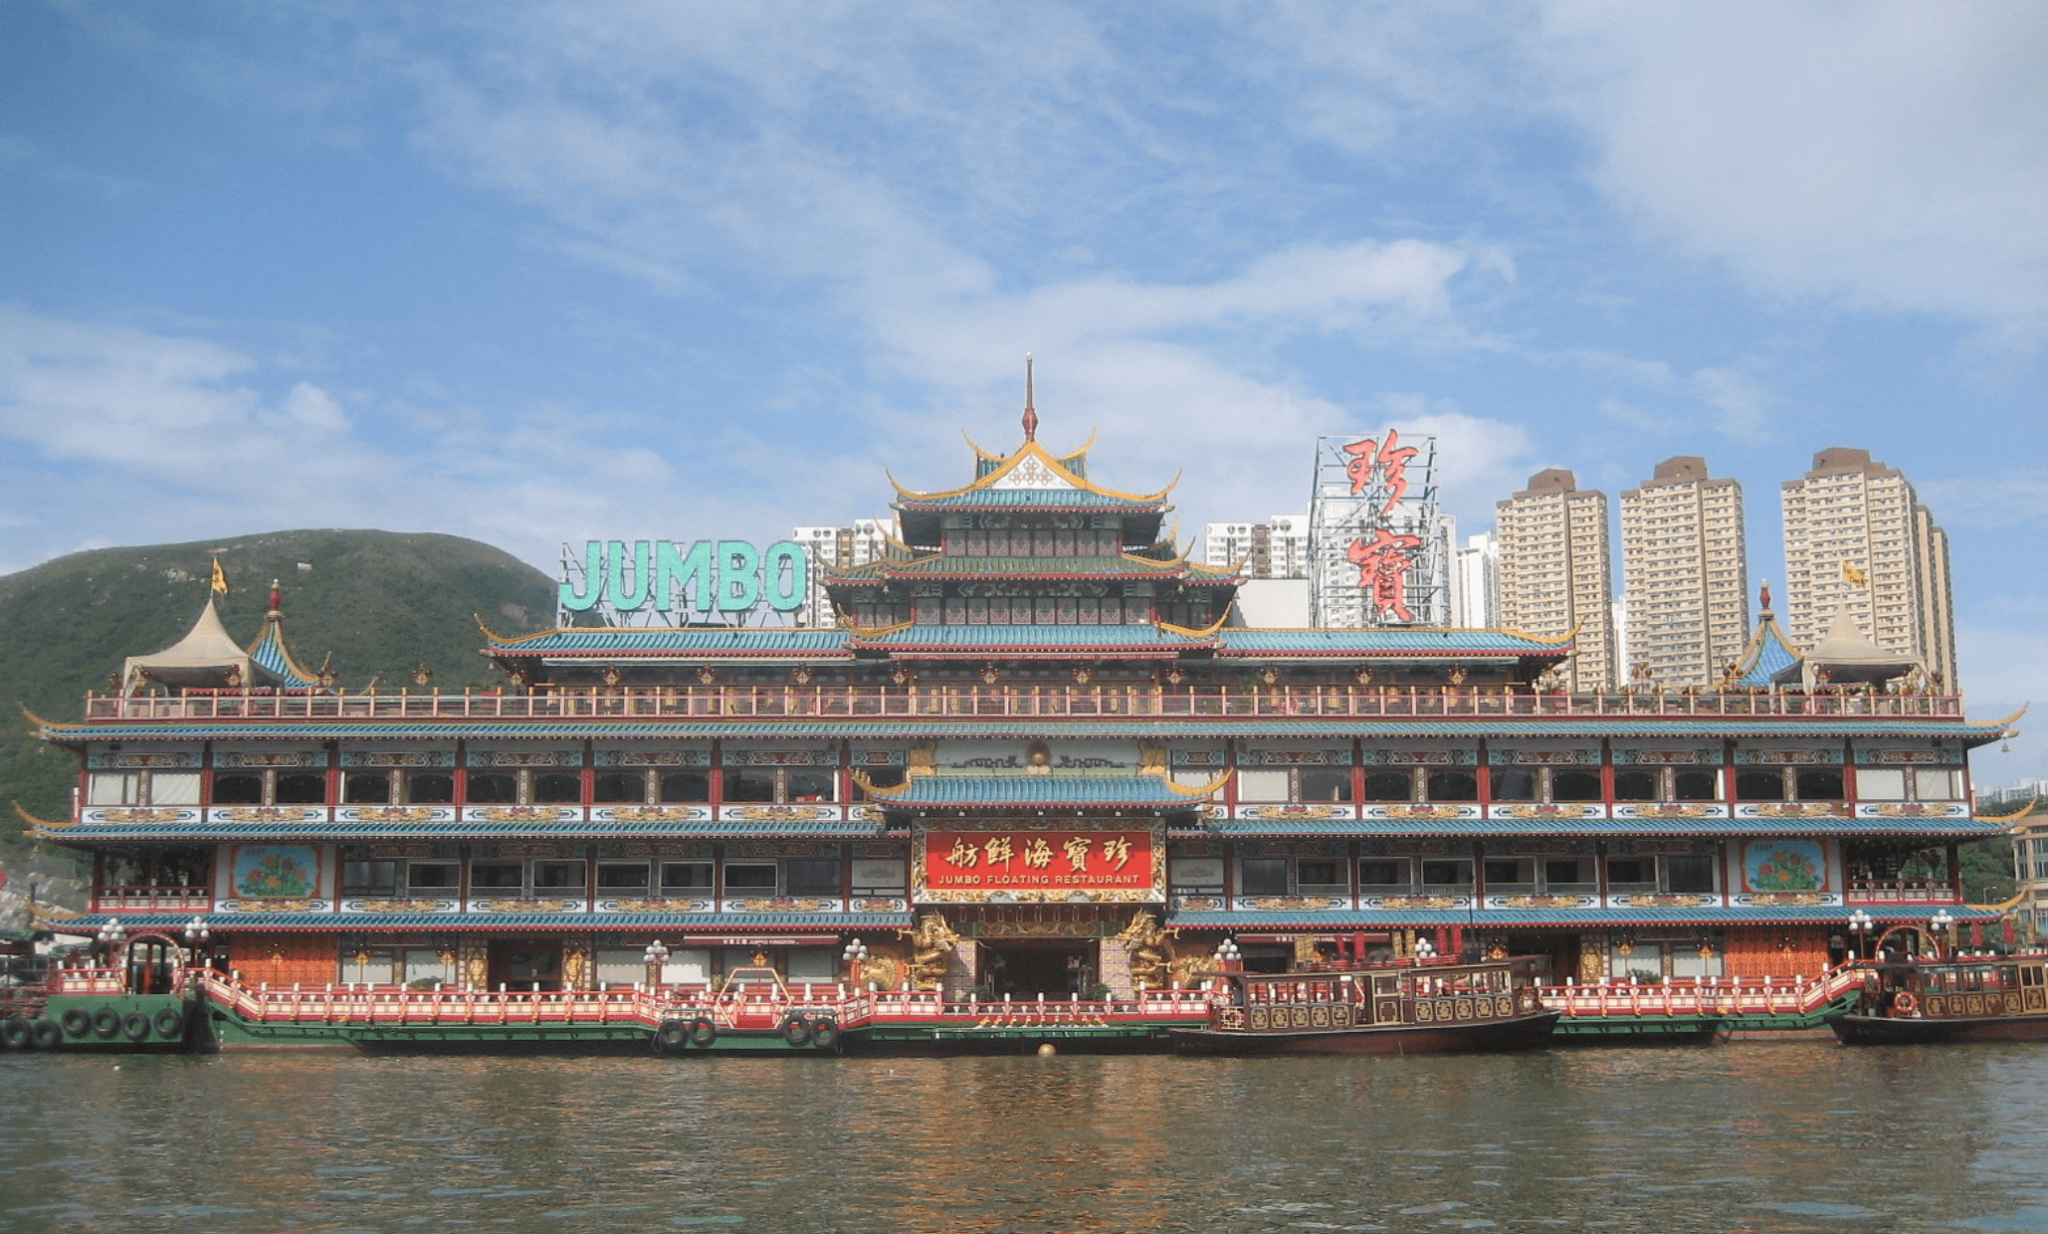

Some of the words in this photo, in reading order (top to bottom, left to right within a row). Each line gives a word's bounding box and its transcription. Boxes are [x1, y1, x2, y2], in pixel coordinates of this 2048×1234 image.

[1343, 428, 1422, 621] 珍寶
[558, 540, 808, 611] JUMBO
[938, 874, 981, 884] JUMBO
[986, 874, 1049, 884] FLOATING
[1055, 874, 1140, 884] RESTAURANT
